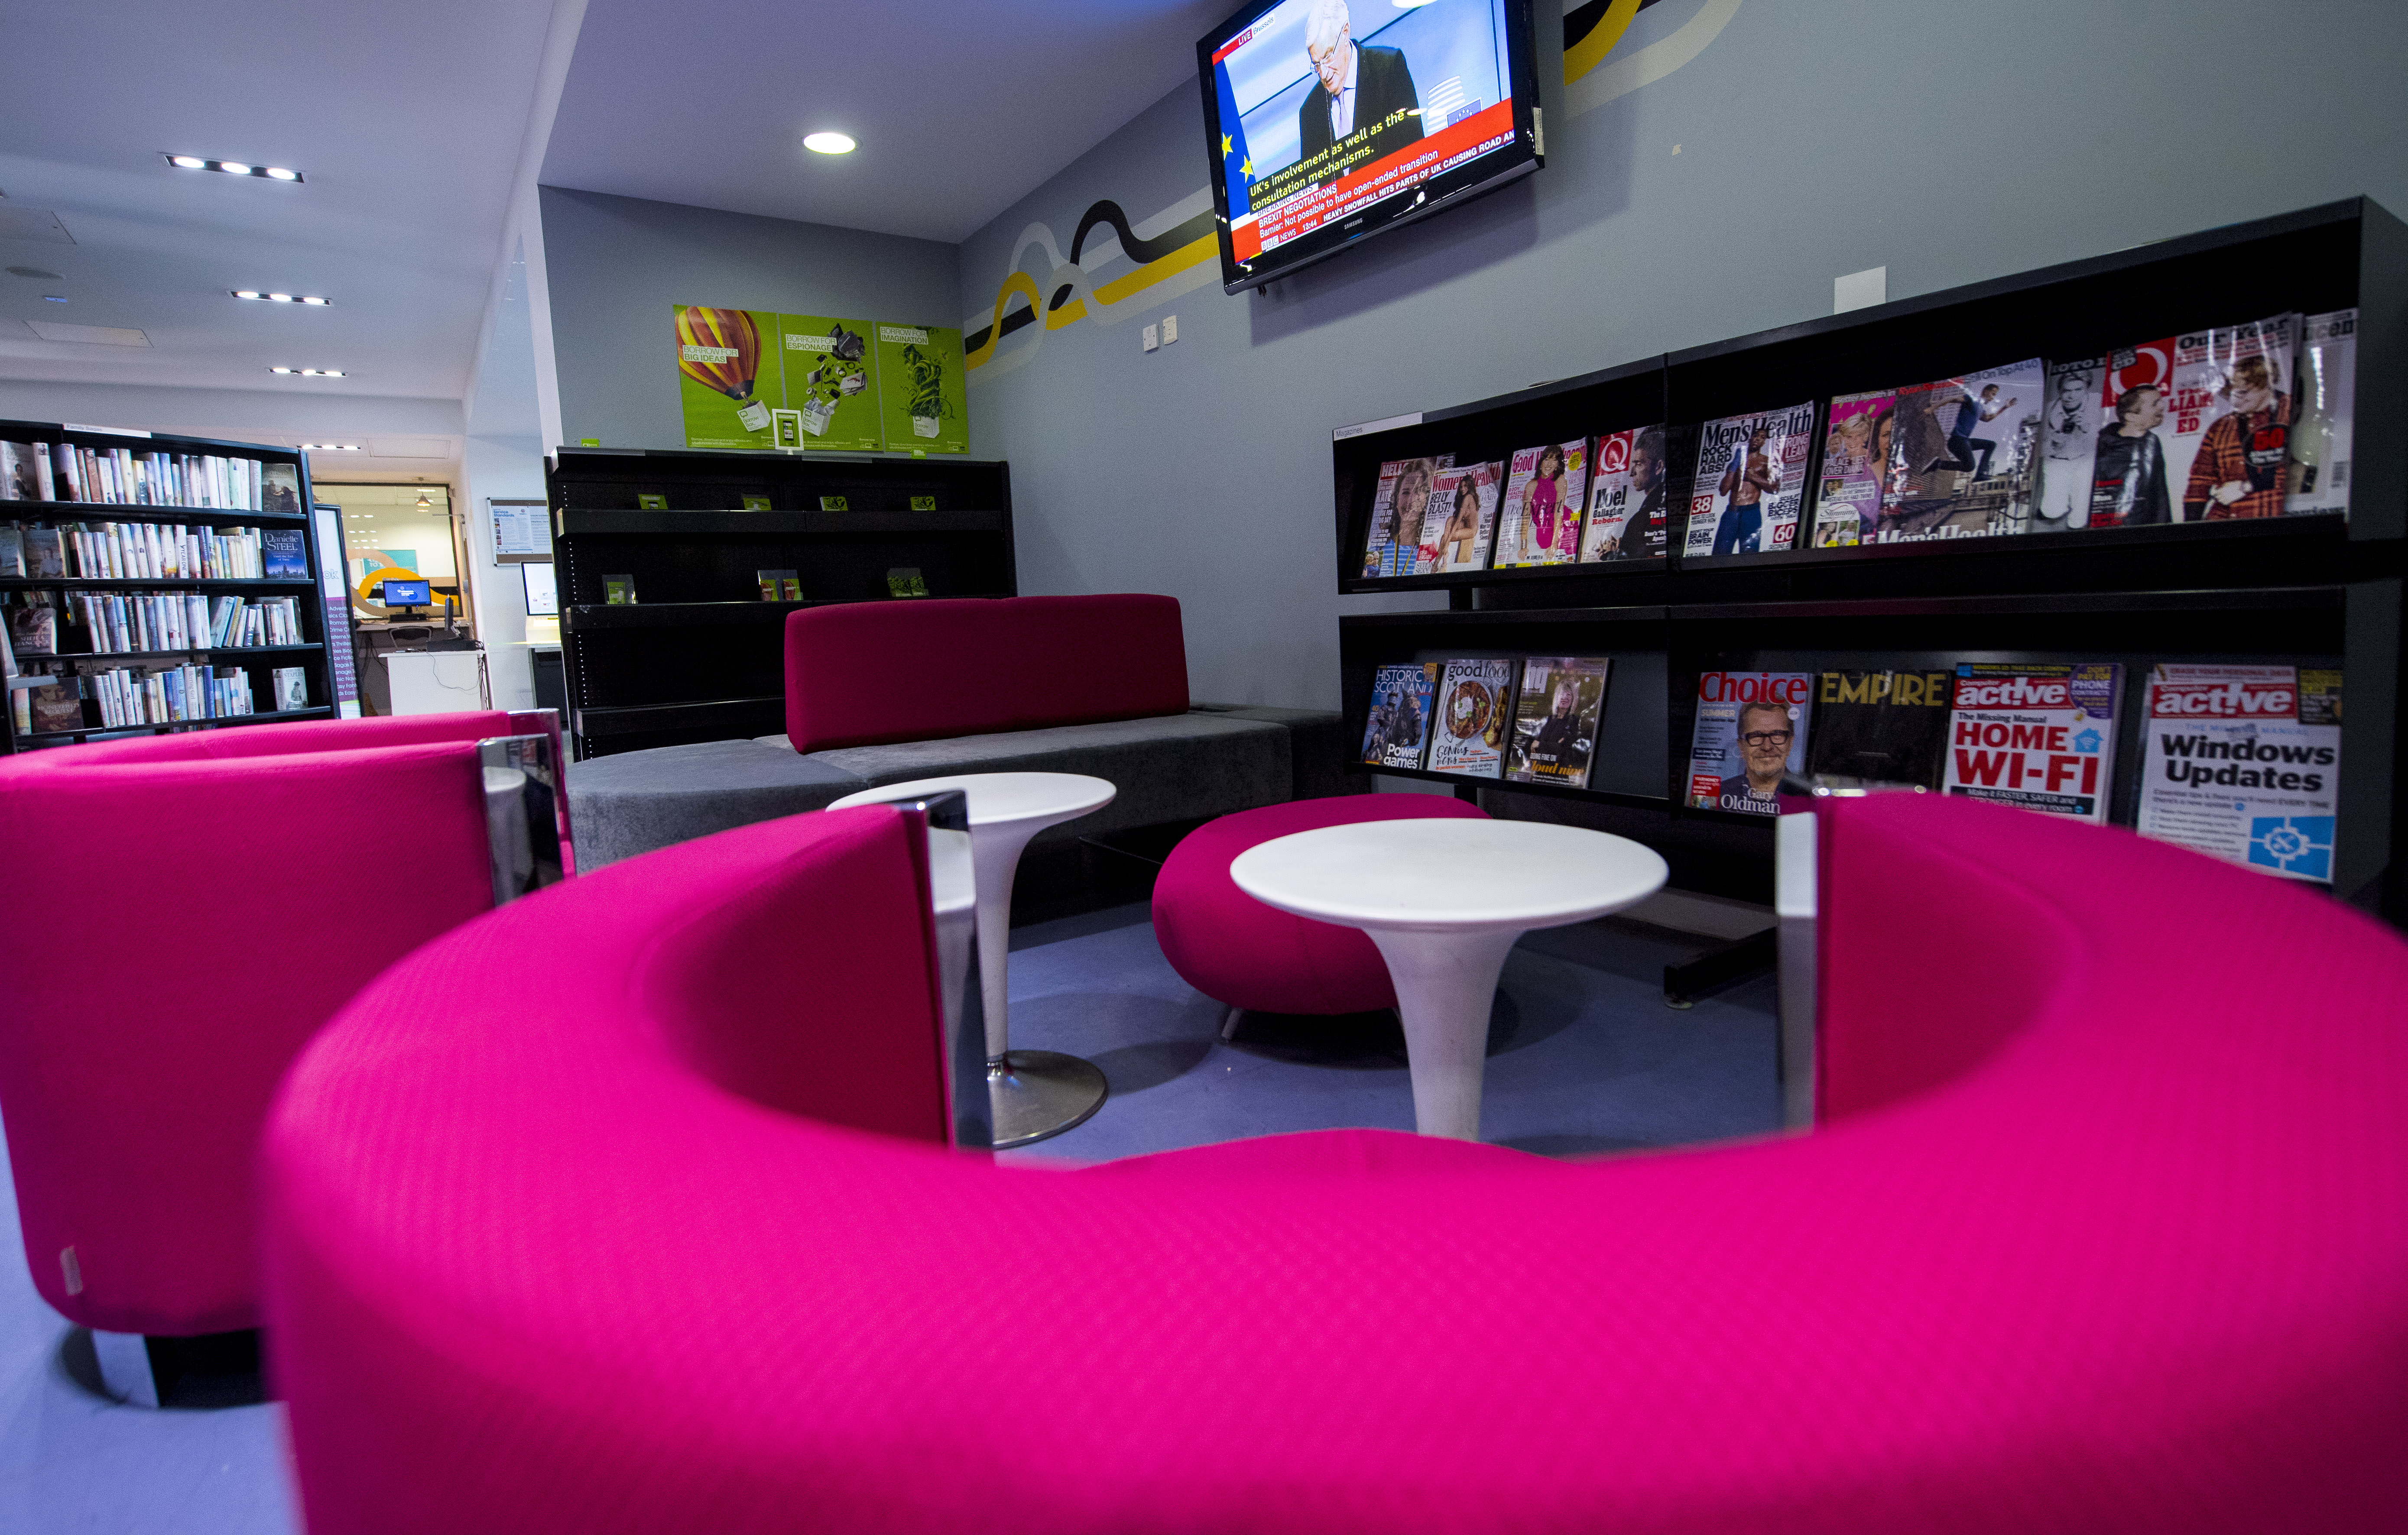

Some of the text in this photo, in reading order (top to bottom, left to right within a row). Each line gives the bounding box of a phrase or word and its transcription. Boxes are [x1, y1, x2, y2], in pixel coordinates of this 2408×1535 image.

[1238, 17, 1274, 46] LIVE Brussels
[1250, 112, 1405, 196] UK's involvement as well as the
[1252, 146, 1374, 211] consultation mechanisms.
[1323, 207, 1343, 222] HEAVY
[1344, 192, 1378, 213] SNOWFALL
[1379, 185, 1395, 197] HITS
[1395, 173, 1418, 189] PARTS
[1419, 168, 1429, 179] OF
[1430, 163, 1442, 174] UK
[1443, 147, 1477, 168] CAUSING
[1478, 136, 1502, 153] ROAD
[1258, 185, 1313, 217] BREAKING NEWS
[1259, 149, 1438, 239] Barnier: Not possible to have open-ended transition
[1258, 183, 1337, 228] BREXIT NEGOTIATIONS
[1302, 218, 1318, 231] 13:44
[1344, 218, 1363, 230] SAMSUNG
[1261, 228, 1297, 251] BBC NEWS
[786, 334, 819, 343] BORROW
[881, 327, 911, 336] BORROW
[881, 334, 928, 344] IMAGINATION
[684, 346, 720, 355] BORROW
[787, 342, 832, 351] ESPIONAGE
[701, 354, 725, 363] IDEAS
[743, 416, 759, 424] Borrow
[1336, 426, 1363, 437] Magazines
[1704, 419, 1751, 448] Men's
[1751, 409, 1811, 439] Health
[1600, 437, 1629, 472] Q
[1702, 444, 1732, 456] ROCK
[1512, 452, 1534, 473] Good
[1700, 453, 1732, 466] HARD
[1698, 463, 1725, 476] ABS!
[1430, 491, 1450, 504] BELLY
[1594, 485, 1628, 509] Noel
[1428, 501, 1451, 515] BLAST!
[1692, 495, 1712, 514] 38
[1593, 507, 1625, 518] Gallagher
[1592, 516, 1623, 525] Reborn.
[264, 533, 299, 542] Danielle
[1773, 524, 1796, 542] 60
[267, 541, 298, 551] STEEL
[1688, 538, 1712, 546] POWER
[1376, 669, 1423, 682] HISTORIC
[1448, 660, 1483, 681] good
[1698, 672, 1808, 704] Choice
[1820, 672, 1946, 706] EMPIRE
[2072, 680, 2111, 690] PHONE
[1701, 709, 1736, 717] SUMMER
[1976, 713, 2012, 723] Missing
[2014, 714, 2047, 723] Manual
[1955, 722, 2070, 752] HOME
[1387, 743, 1420, 758] Power
[2161, 734, 2335, 766] Windows
[1383, 755, 1418, 769] games
[1954, 748, 2100, 795] WI-FI
[2166, 759, 2323, 792] Updates
[1747, 787, 1774, 802] Gary
[1720, 793, 1781, 814] Oldman
